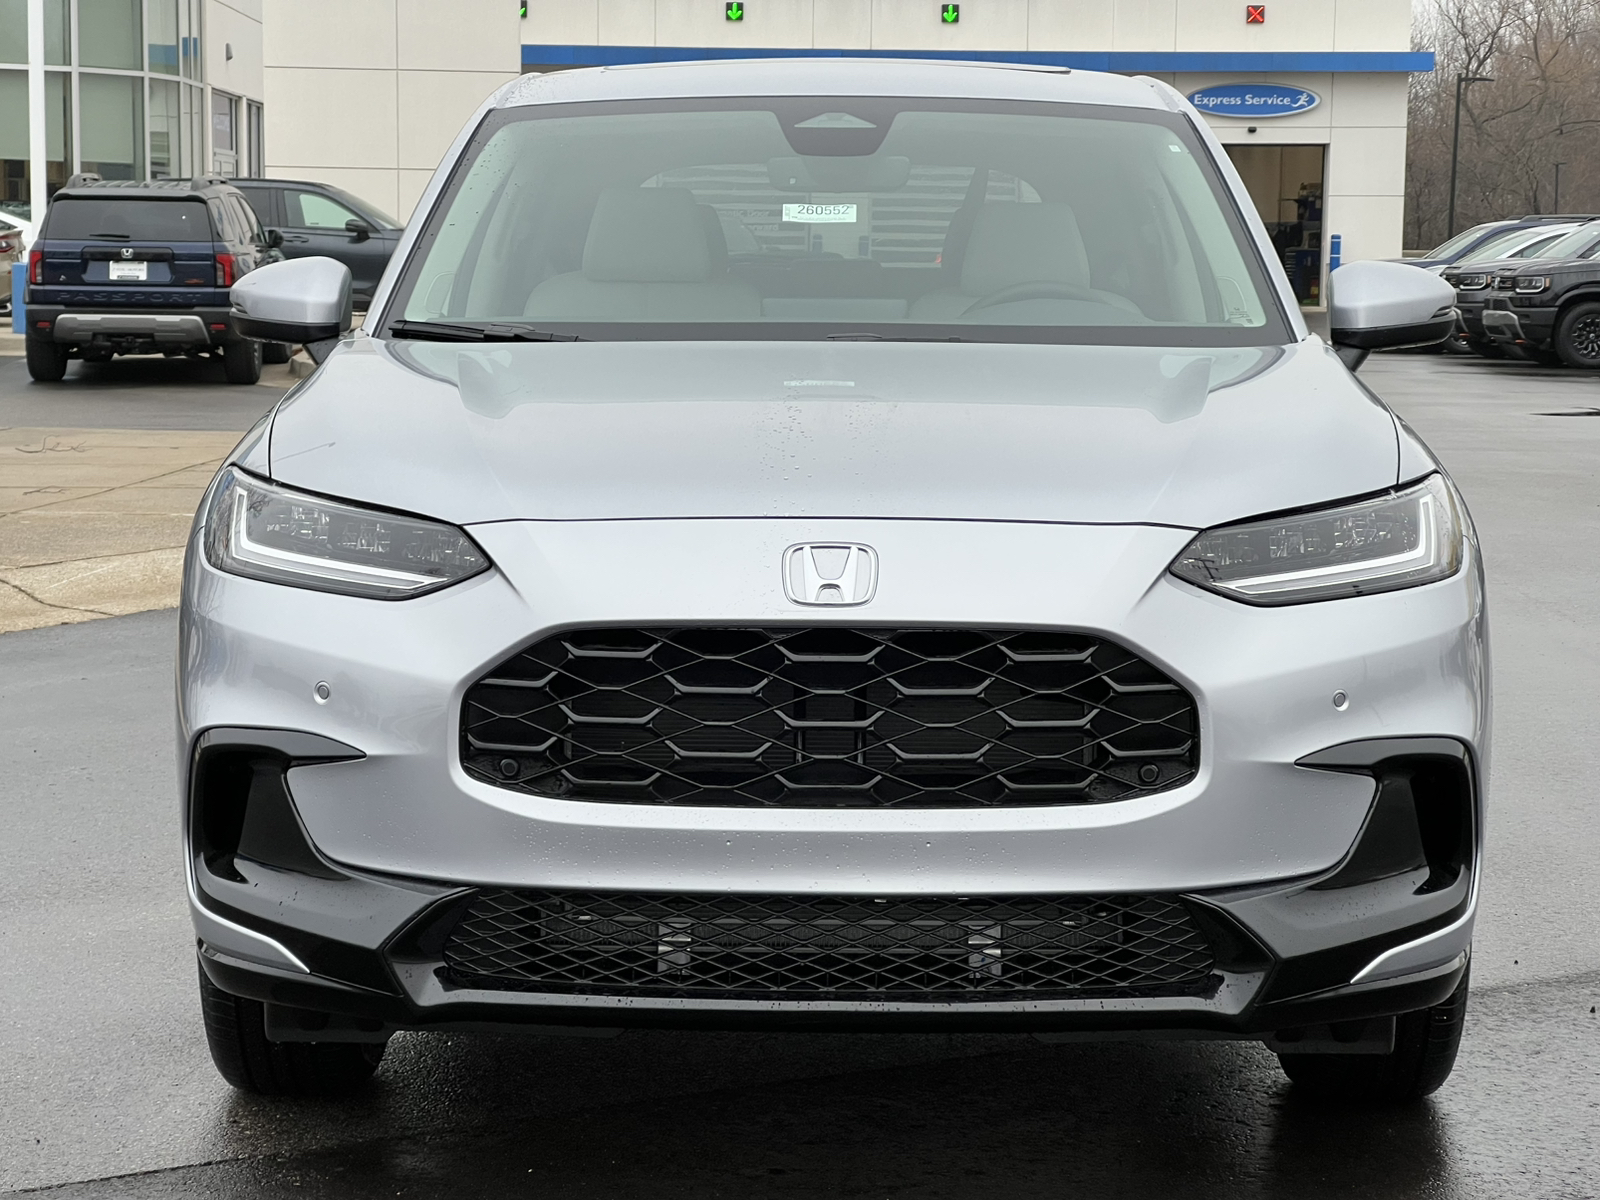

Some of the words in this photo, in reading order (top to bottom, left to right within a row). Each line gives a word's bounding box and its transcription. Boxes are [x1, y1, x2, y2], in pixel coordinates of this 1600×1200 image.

[1194, 94, 1241, 107] Express
[1245, 94, 1291, 105] Service
[797, 204, 850, 215] 260552
[57, 292, 201, 301] PASSPORT
